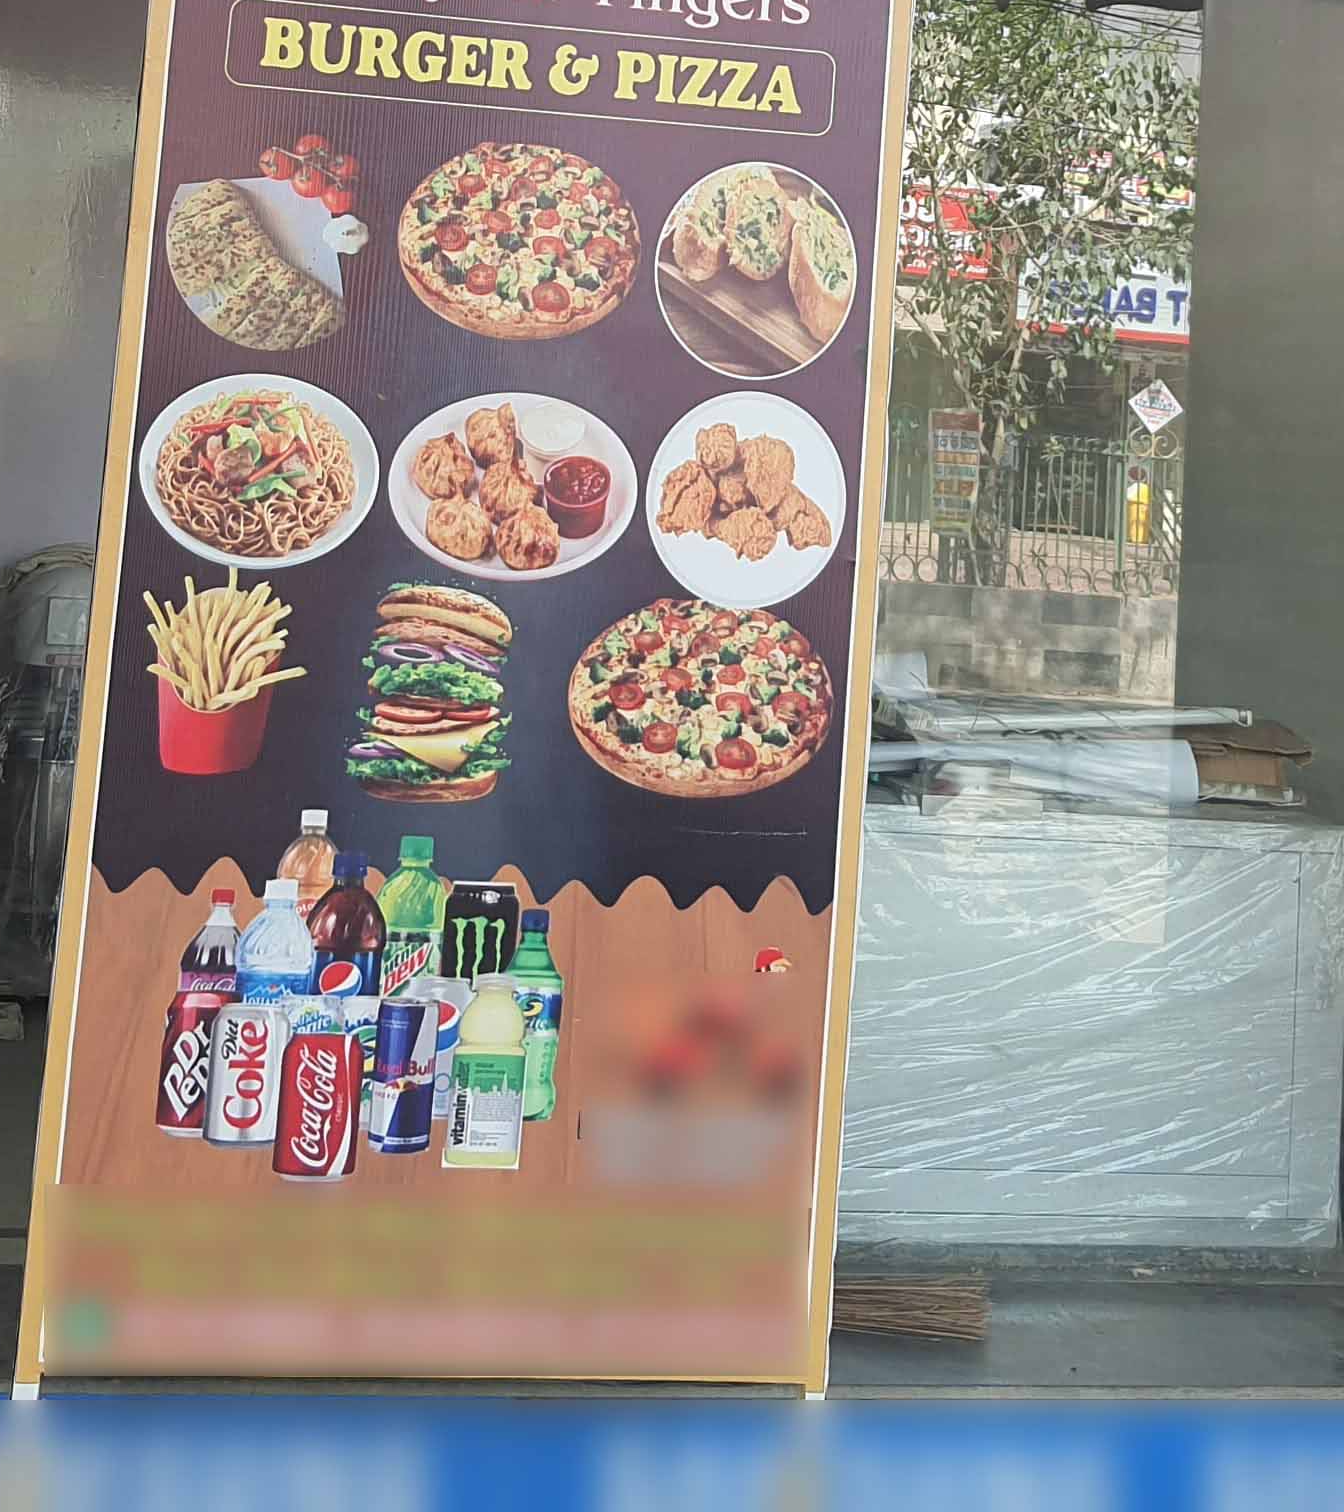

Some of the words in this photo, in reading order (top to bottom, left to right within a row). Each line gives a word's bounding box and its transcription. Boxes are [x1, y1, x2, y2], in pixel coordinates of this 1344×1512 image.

[260, 16, 533, 91] BURGER
[547, 43, 599, 95] &
[613, 50, 803, 115] PIZZA
[222, 1018, 239, 1059] Diet
[407, 1057, 436, 1075] Bull
[223, 1019, 269, 1129] Coke
